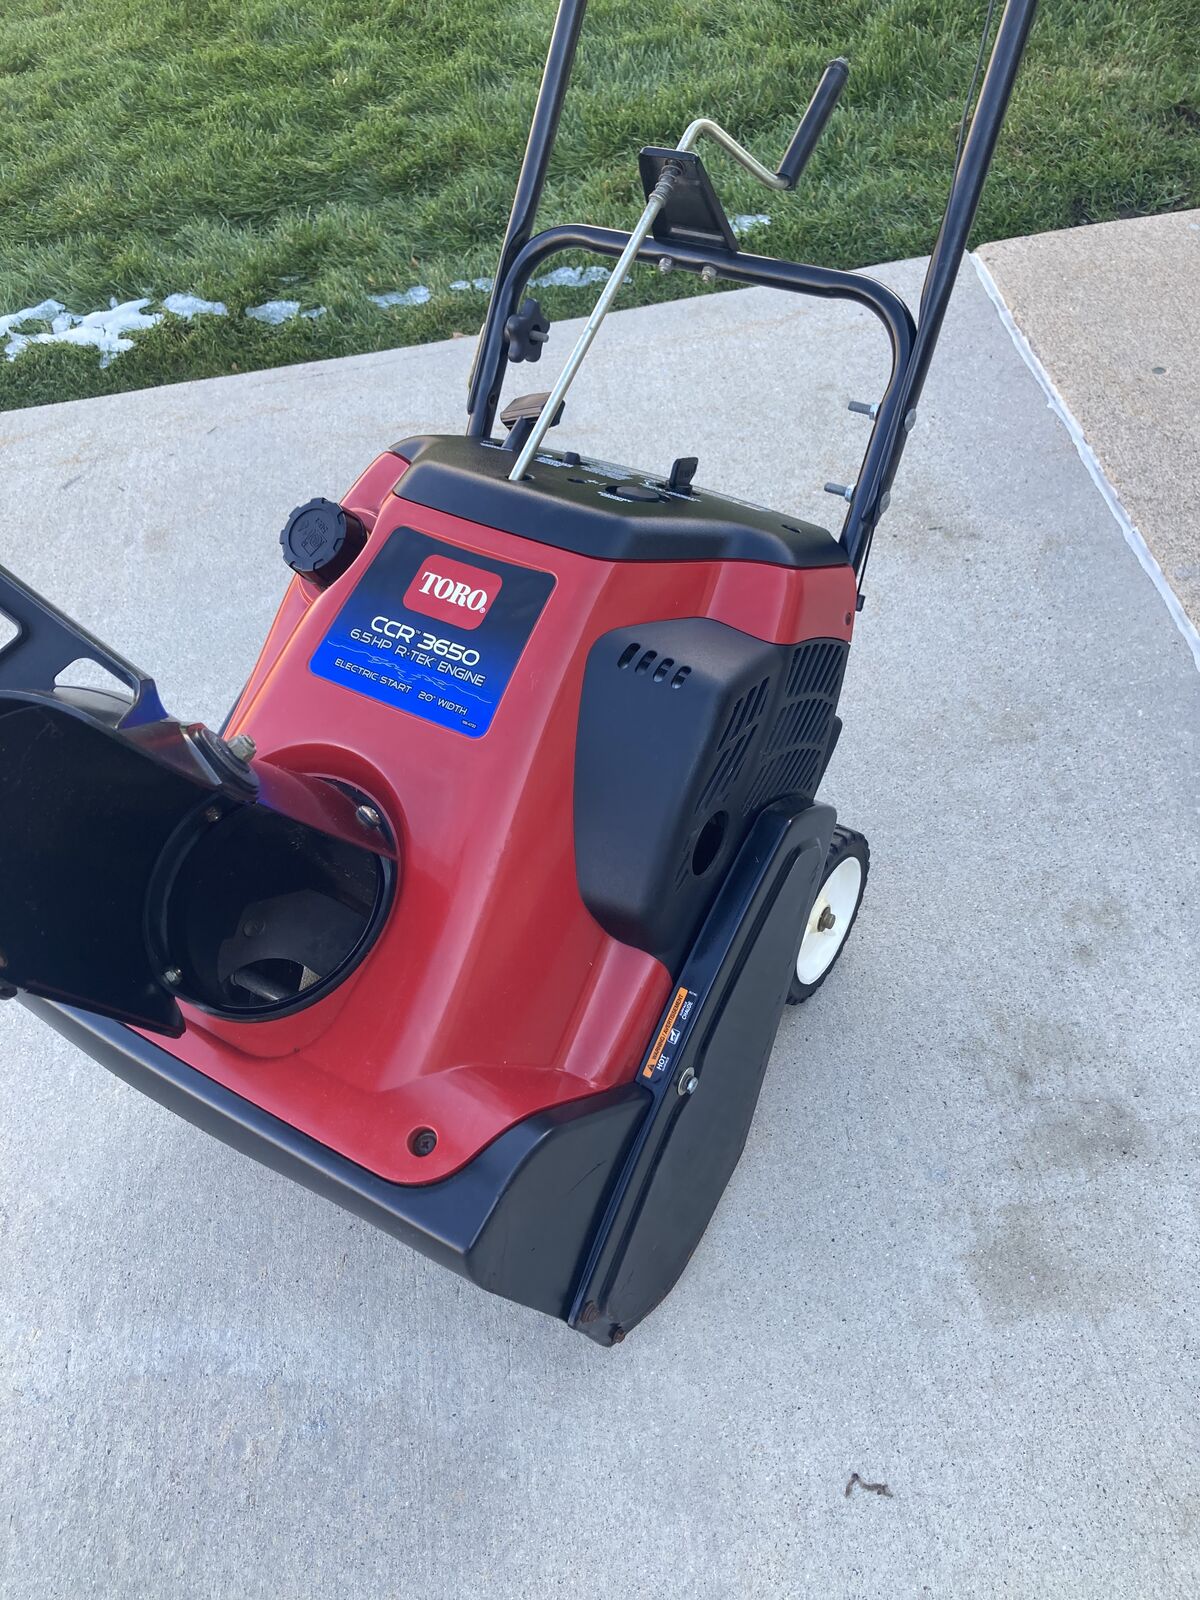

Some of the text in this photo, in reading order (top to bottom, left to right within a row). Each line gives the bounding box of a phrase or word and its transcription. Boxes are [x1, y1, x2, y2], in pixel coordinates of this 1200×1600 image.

[419, 571, 488, 611] TORO
[417, 632, 480, 666] 3650
[334, 658, 379, 681] ELECTRIC
[380, 676, 413, 693] START
[437, 698, 468, 716] WIDTH
[437, 661, 486, 687] ENGINE
[652, 1035, 665, 1060] WARNING
[663, 993, 684, 1034] AVERTISSEMENT
[656, 1053, 667, 1070] HOT
